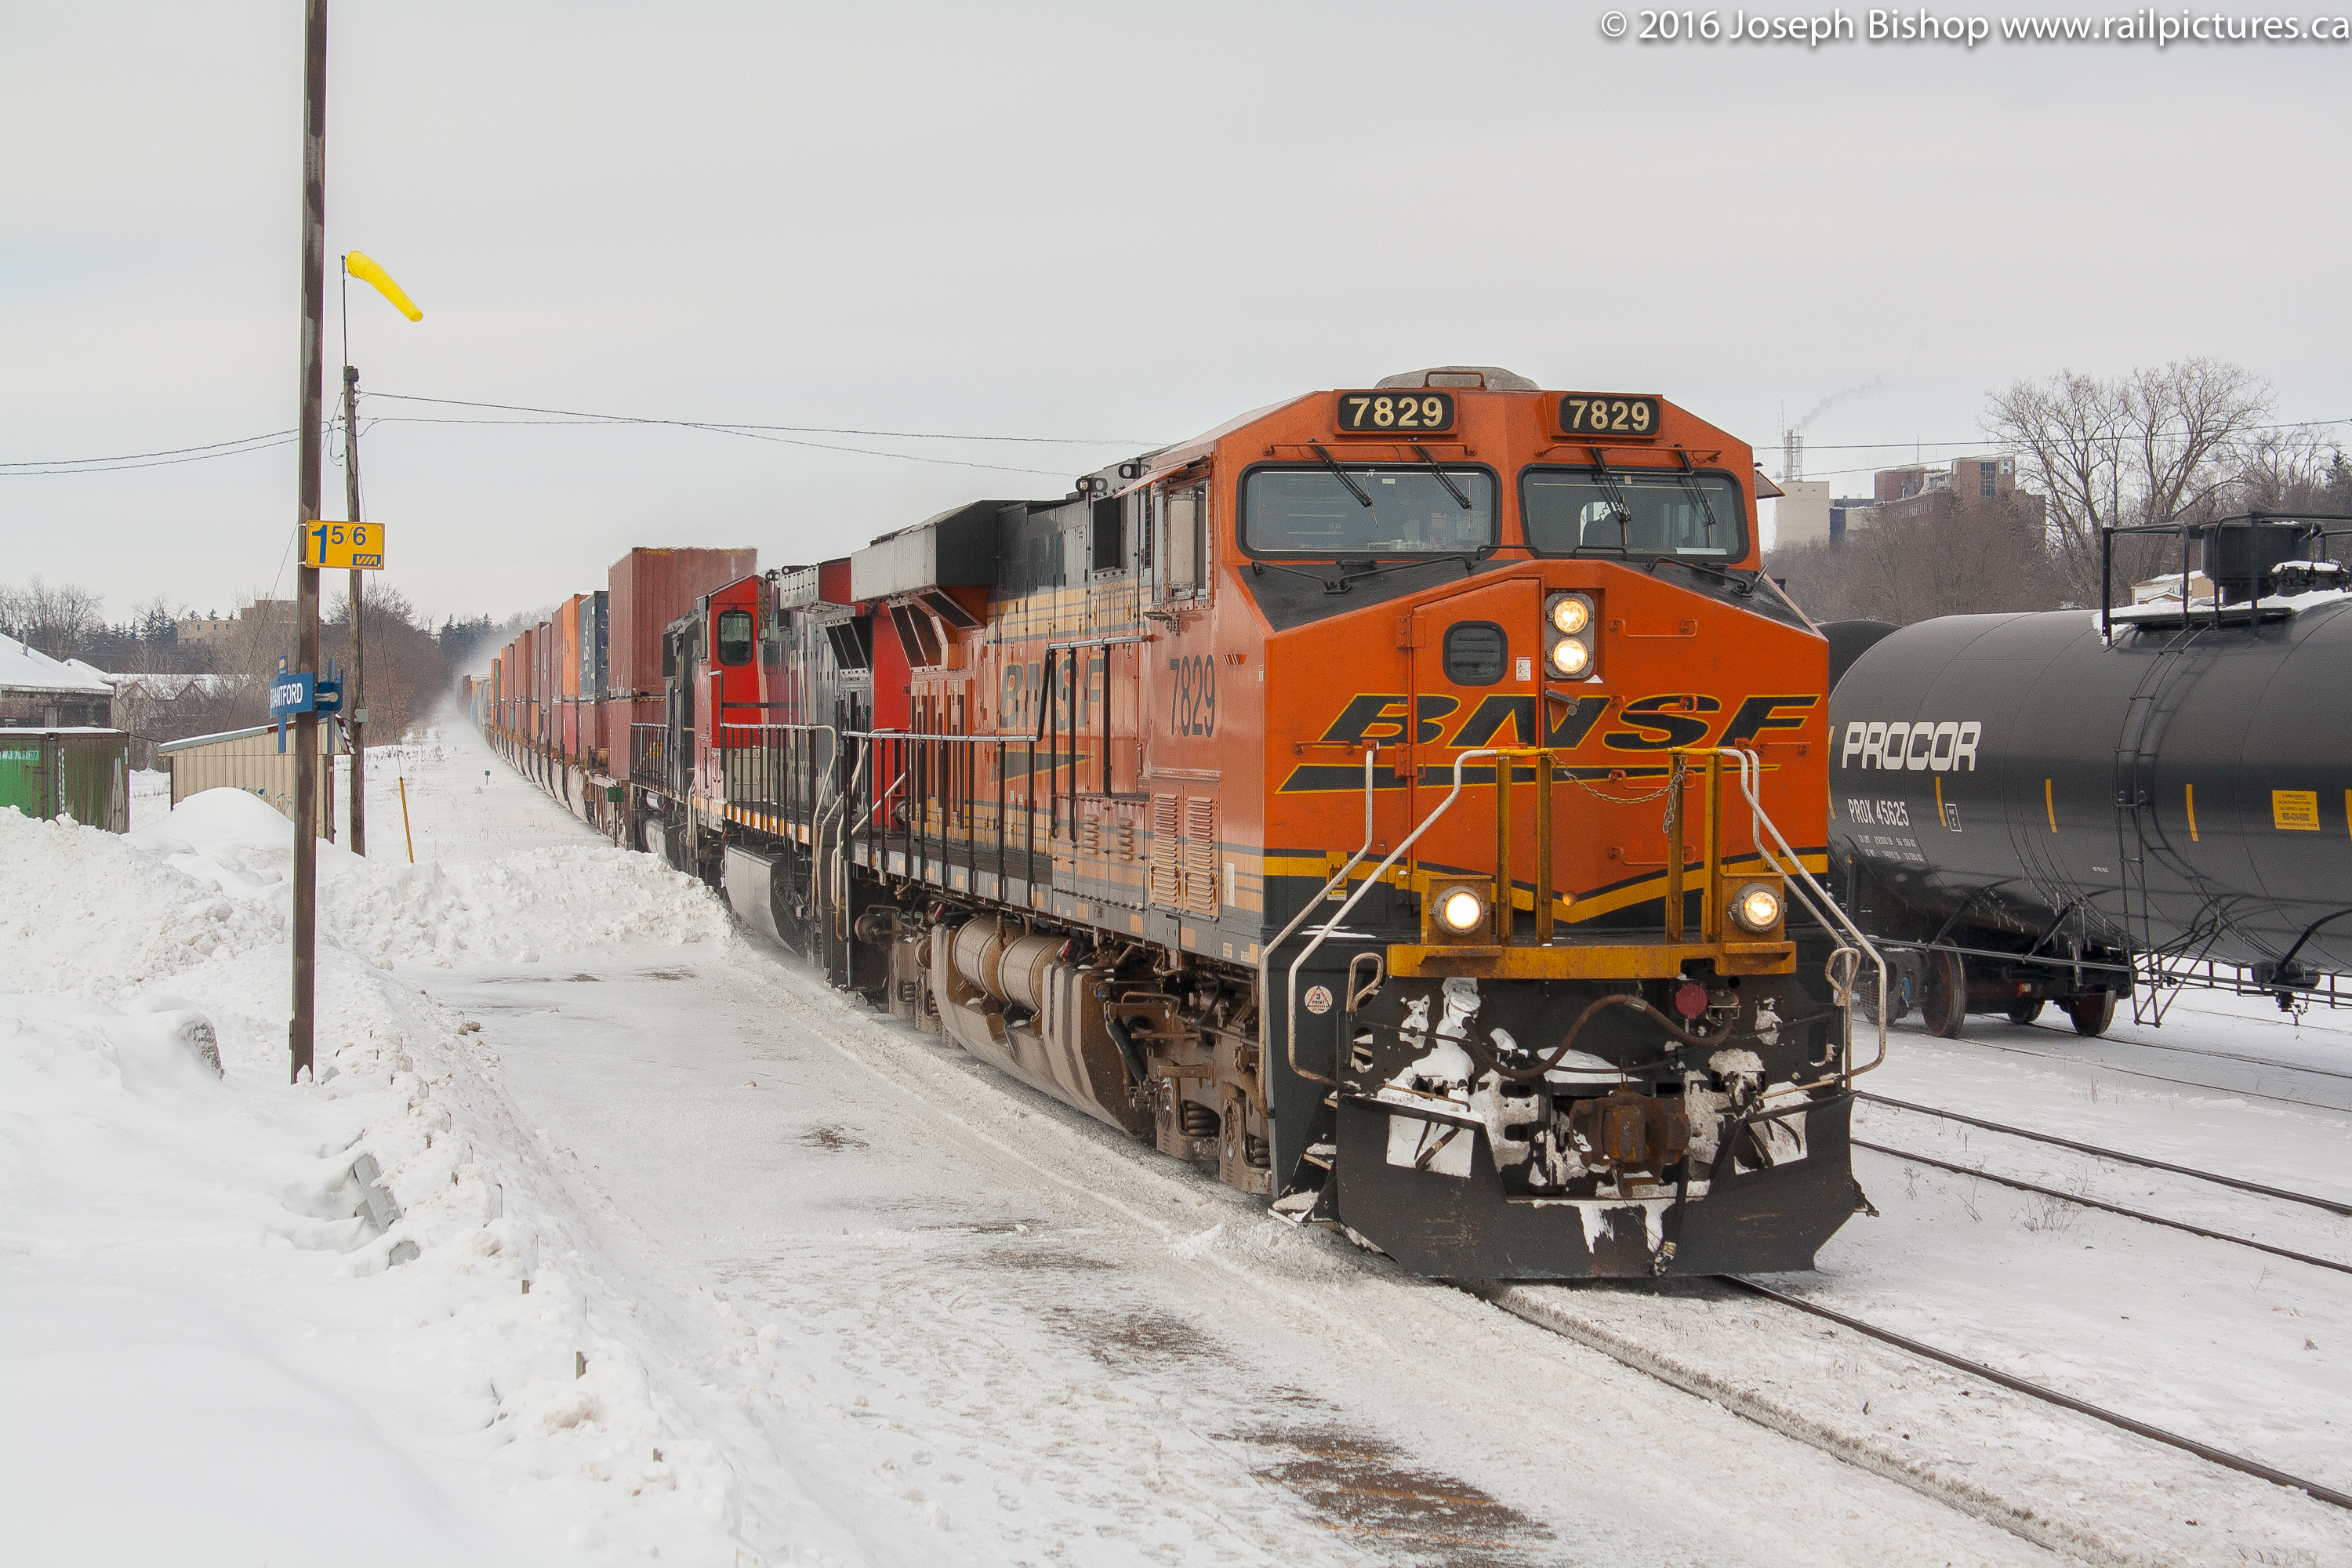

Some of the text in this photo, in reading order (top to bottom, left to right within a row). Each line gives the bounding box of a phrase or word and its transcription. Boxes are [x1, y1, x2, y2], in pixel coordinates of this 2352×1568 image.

[1348, 397, 1443, 427] 7829
[1569, 400, 1650, 431] 7829
[355, 555, 378, 565] VIA
[998, 652, 1110, 735] BNSF
[1169, 655, 1215, 737] 7829
[1313, 693, 1823, 753] BNSF
[1842, 721, 1982, 771] PROCOR
[1847, 799, 1909, 826] PROX 45625
